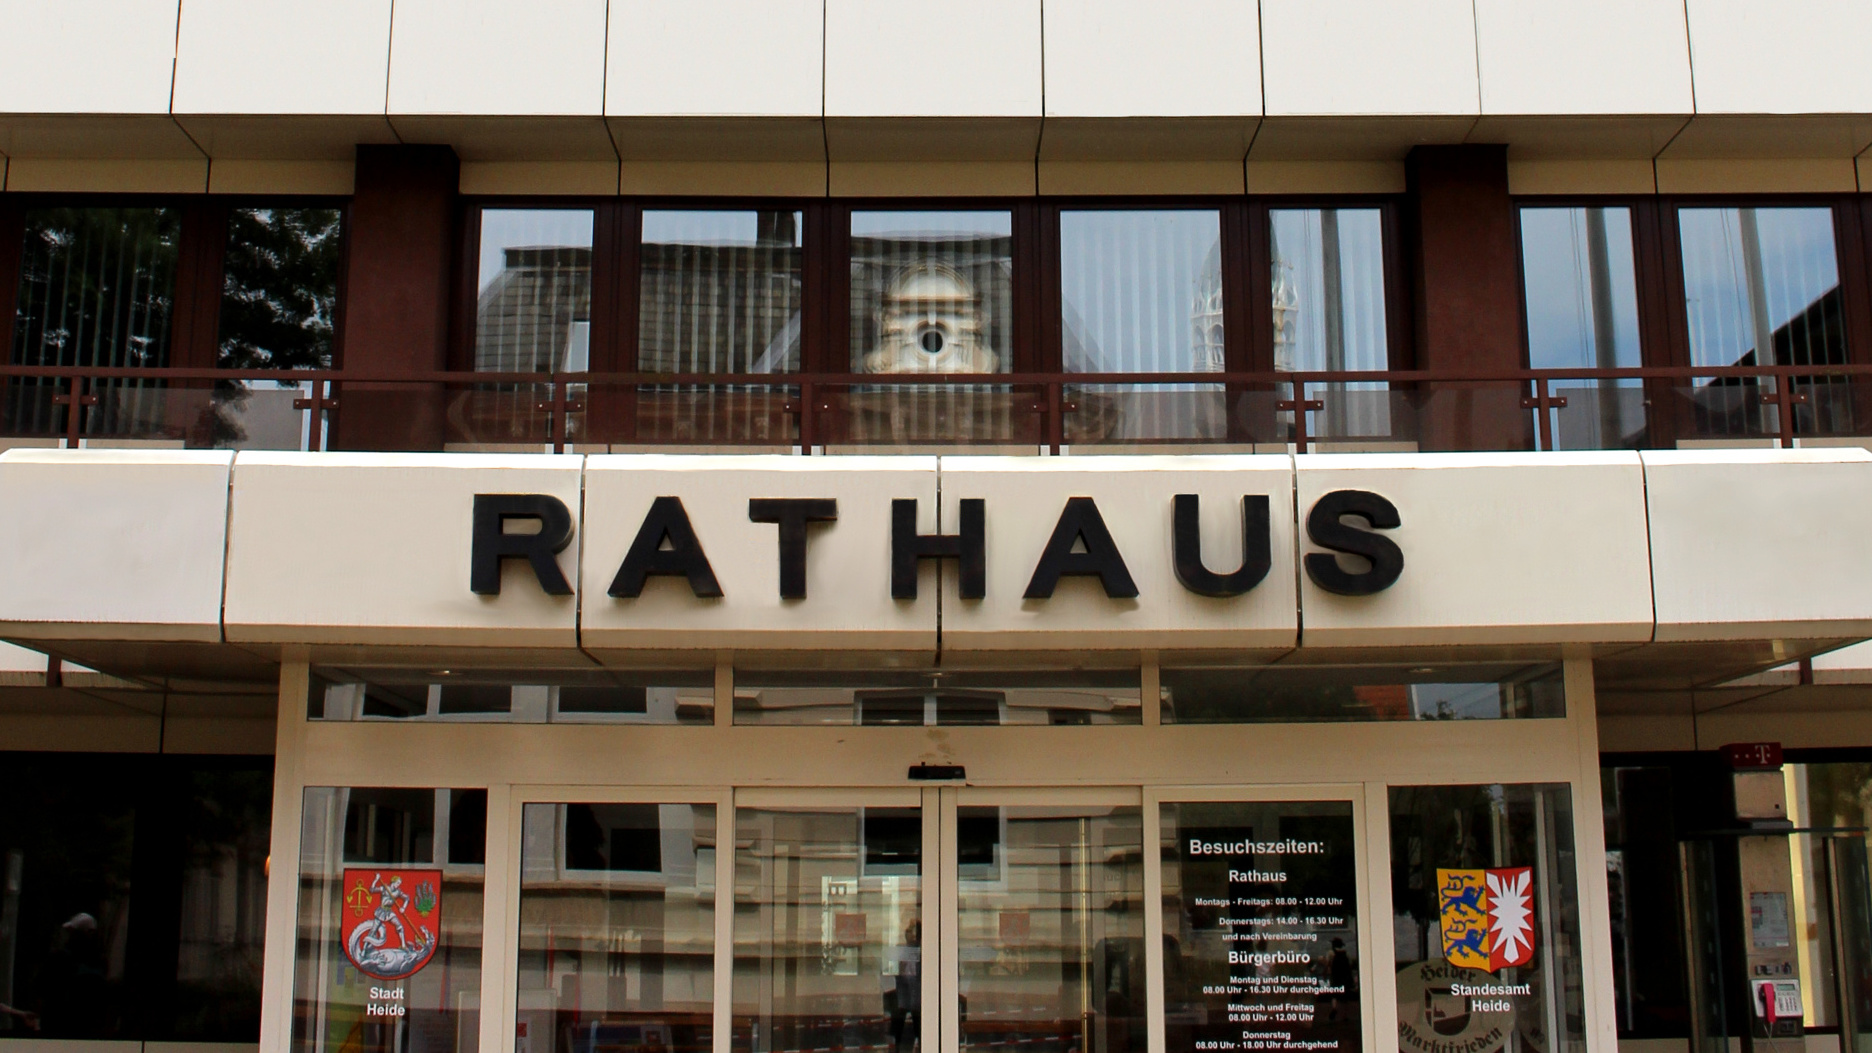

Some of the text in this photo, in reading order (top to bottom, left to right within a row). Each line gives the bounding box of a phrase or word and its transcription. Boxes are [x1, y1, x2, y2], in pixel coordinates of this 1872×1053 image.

[470, 489, 1405, 600] RATHAUS
[1754, 744, 1770, 764] T
[1189, 838, 1325, 856] Besuchszeiten:
[1228, 869, 1288, 883] Rathaus
[1195, 897, 1230, 907] Montags
[1237, 897, 1274, 907] Freitags:
[1275, 897, 1297, 906] 08.00
[1304, 897, 1326, 906] 12.00
[1327, 897, 1343, 906] Uhr
[1219, 916, 1274, 927] Donnerstags:
[1276, 916, 1298, 925] 14.00
[1305, 916, 1327, 925] 16.30
[1328, 916, 1343, 925] Uhr
[1222, 932, 1318, 942] und nach Vereinbarung
[1228, 950, 1311, 967] Bürgerbüro
[1229, 975, 1318, 985] Montag und Dienstag
[369, 986, 405, 1000] Stadt
[1202, 985, 1225, 994] 08.00
[1226, 985, 1242, 994] Uhr
[1249, 985, 1271, 994] 16.30
[1272, 985, 1288, 994] Uhr
[1290, 985, 1345, 994] durchgehend
[1450, 984, 1531, 996] Standesamt
[366, 1003, 406, 1016] Heide
[1227, 1003, 1315, 1013] Mittwoch und Freitag
[1471, 1000, 1511, 1012] Heide
[1228, 1013, 1251, 1022] 08.00
[1252, 1013, 1268, 1022] Uhr
[1275, 1013, 1297, 1022] 12.00
[1298, 1013, 1313, 1022] Uhr
[1242, 1030, 1291, 1042] Donnerstag
[1195, 1041, 1218, 1050] 08.00
[1219, 1041, 1234, 1050] Uhr
[1242, 1041, 1265, 1050] 18.00
[1266, 1041, 1282, 1050] Uhr
[1283, 1039, 1339, 1050] durchgehend
